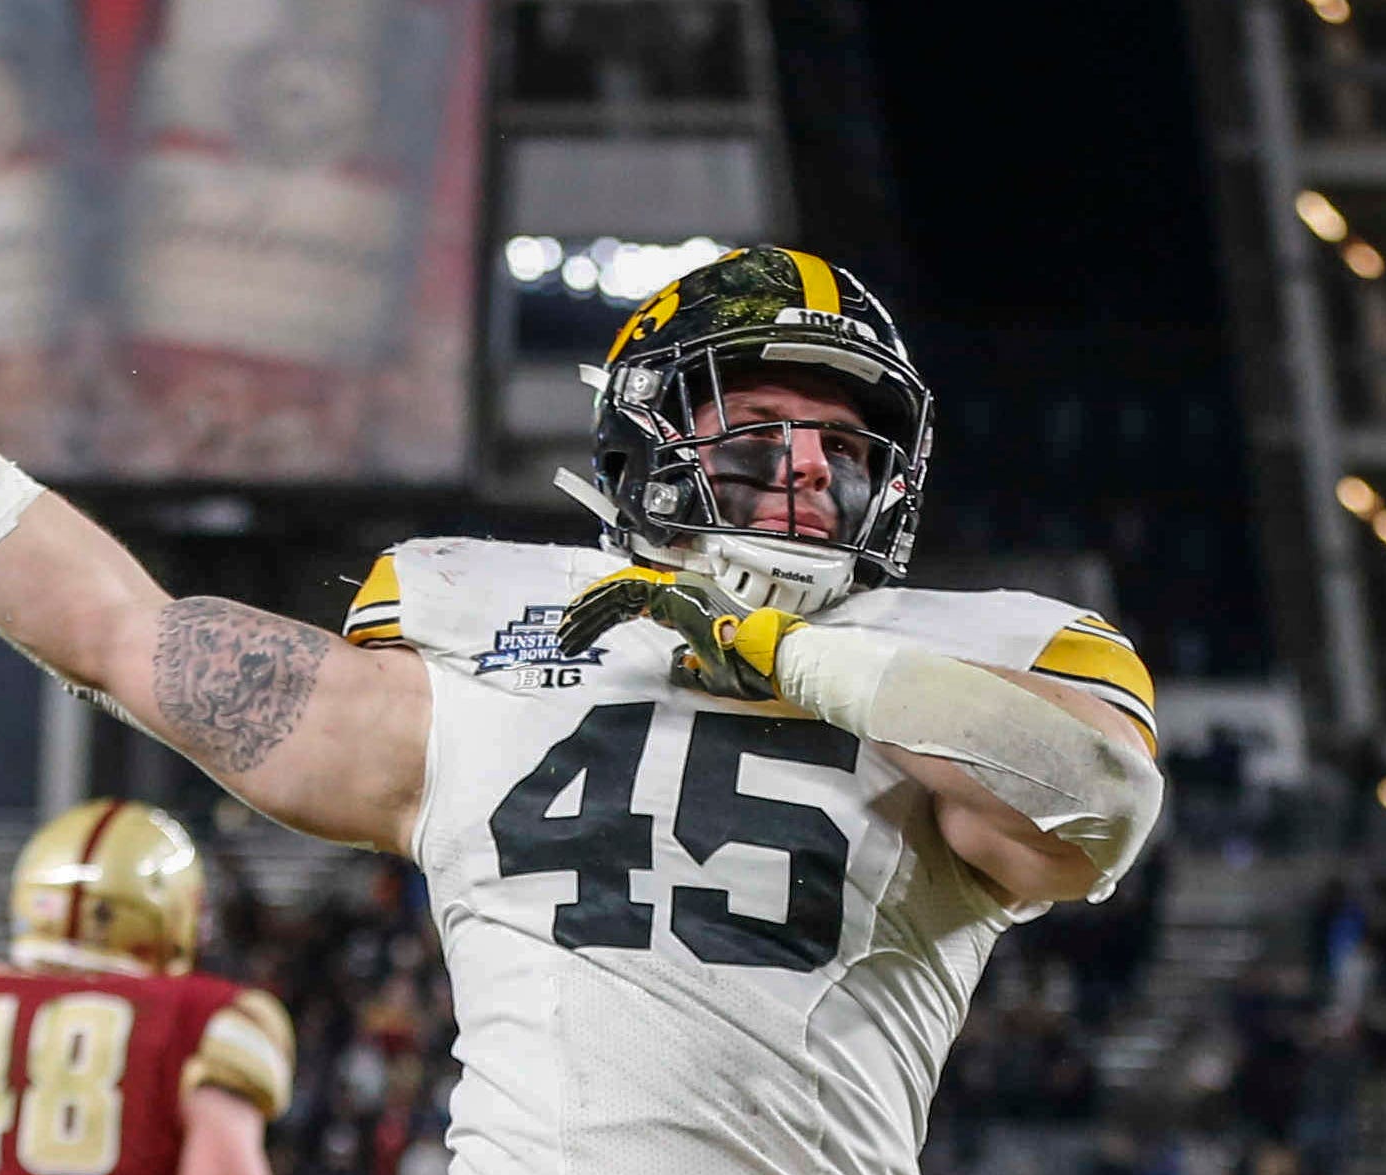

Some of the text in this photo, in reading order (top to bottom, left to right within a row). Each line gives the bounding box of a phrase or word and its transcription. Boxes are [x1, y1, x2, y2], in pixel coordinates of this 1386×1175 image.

[772, 567, 814, 584] Riddell
[499, 633, 563, 651] PINSTR
[489, 700, 859, 972] 45
